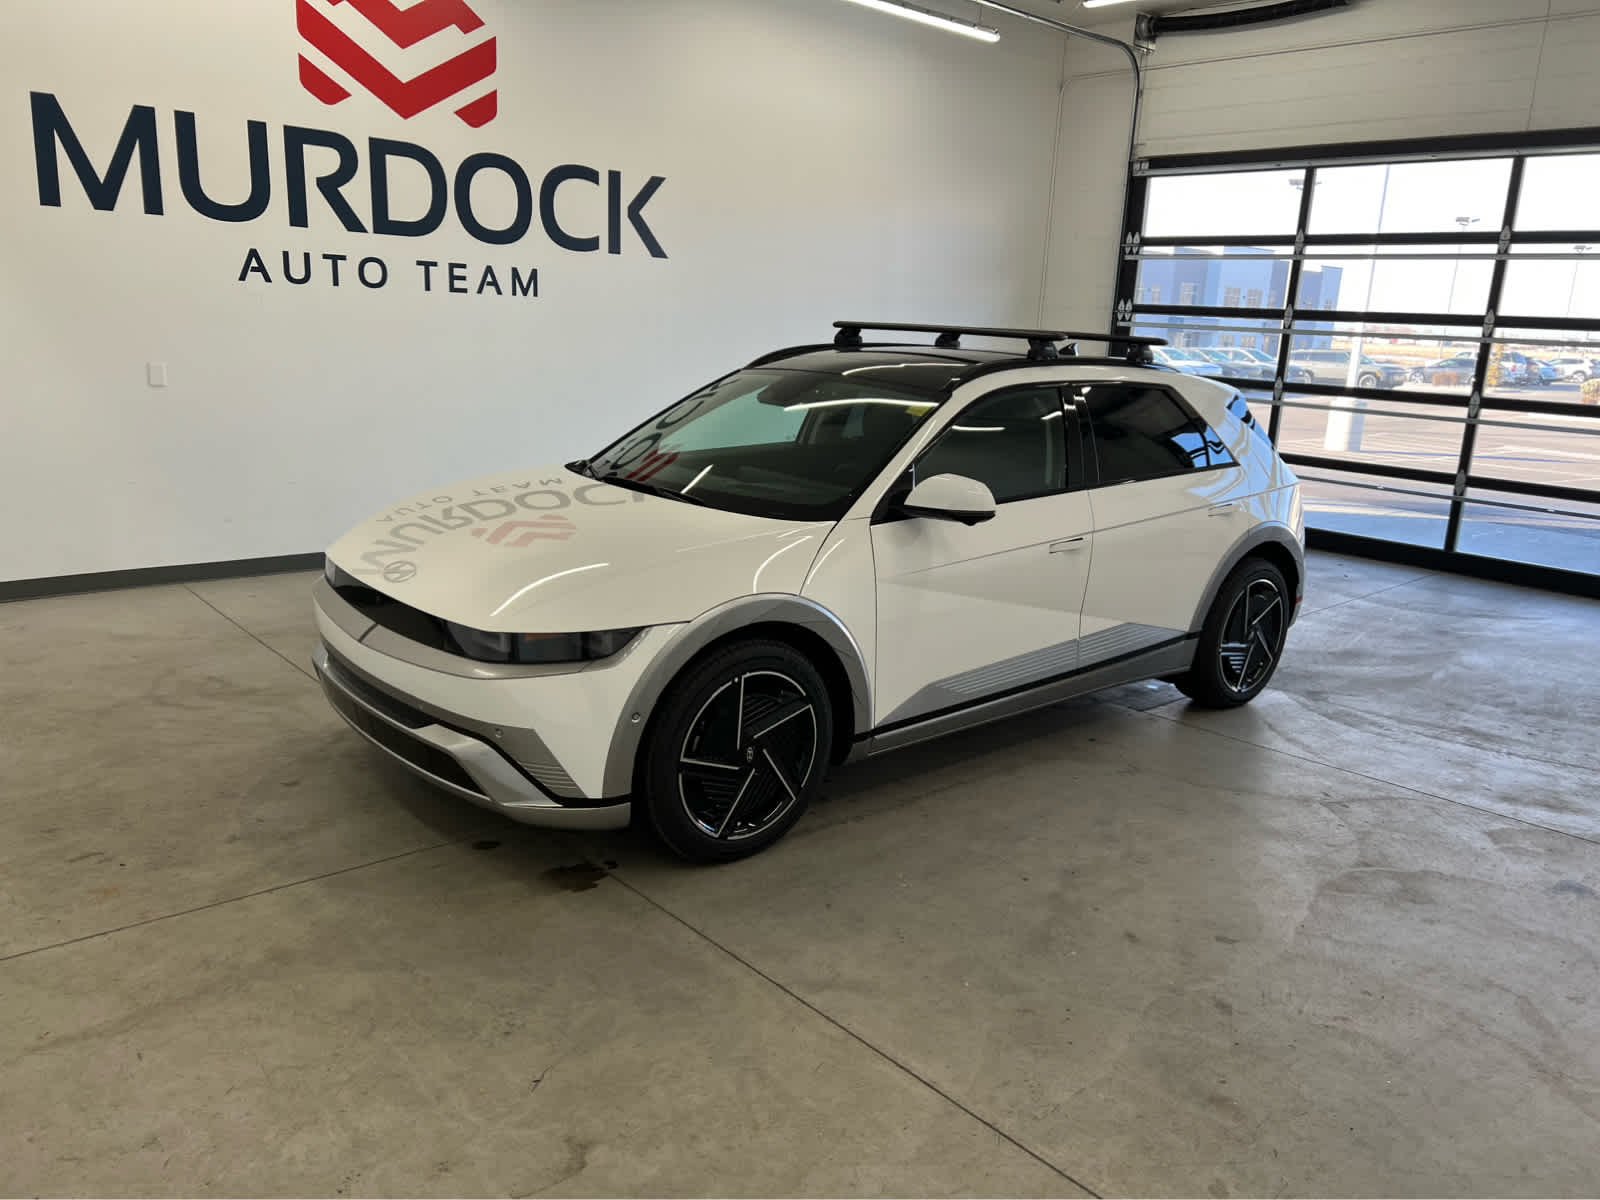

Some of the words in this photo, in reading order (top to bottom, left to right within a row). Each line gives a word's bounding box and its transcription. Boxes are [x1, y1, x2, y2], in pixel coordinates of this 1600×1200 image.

[30, 91, 668, 259] MURDOCK
[238, 247, 389, 289] AUTO
[415, 260, 539, 298] TEAM
